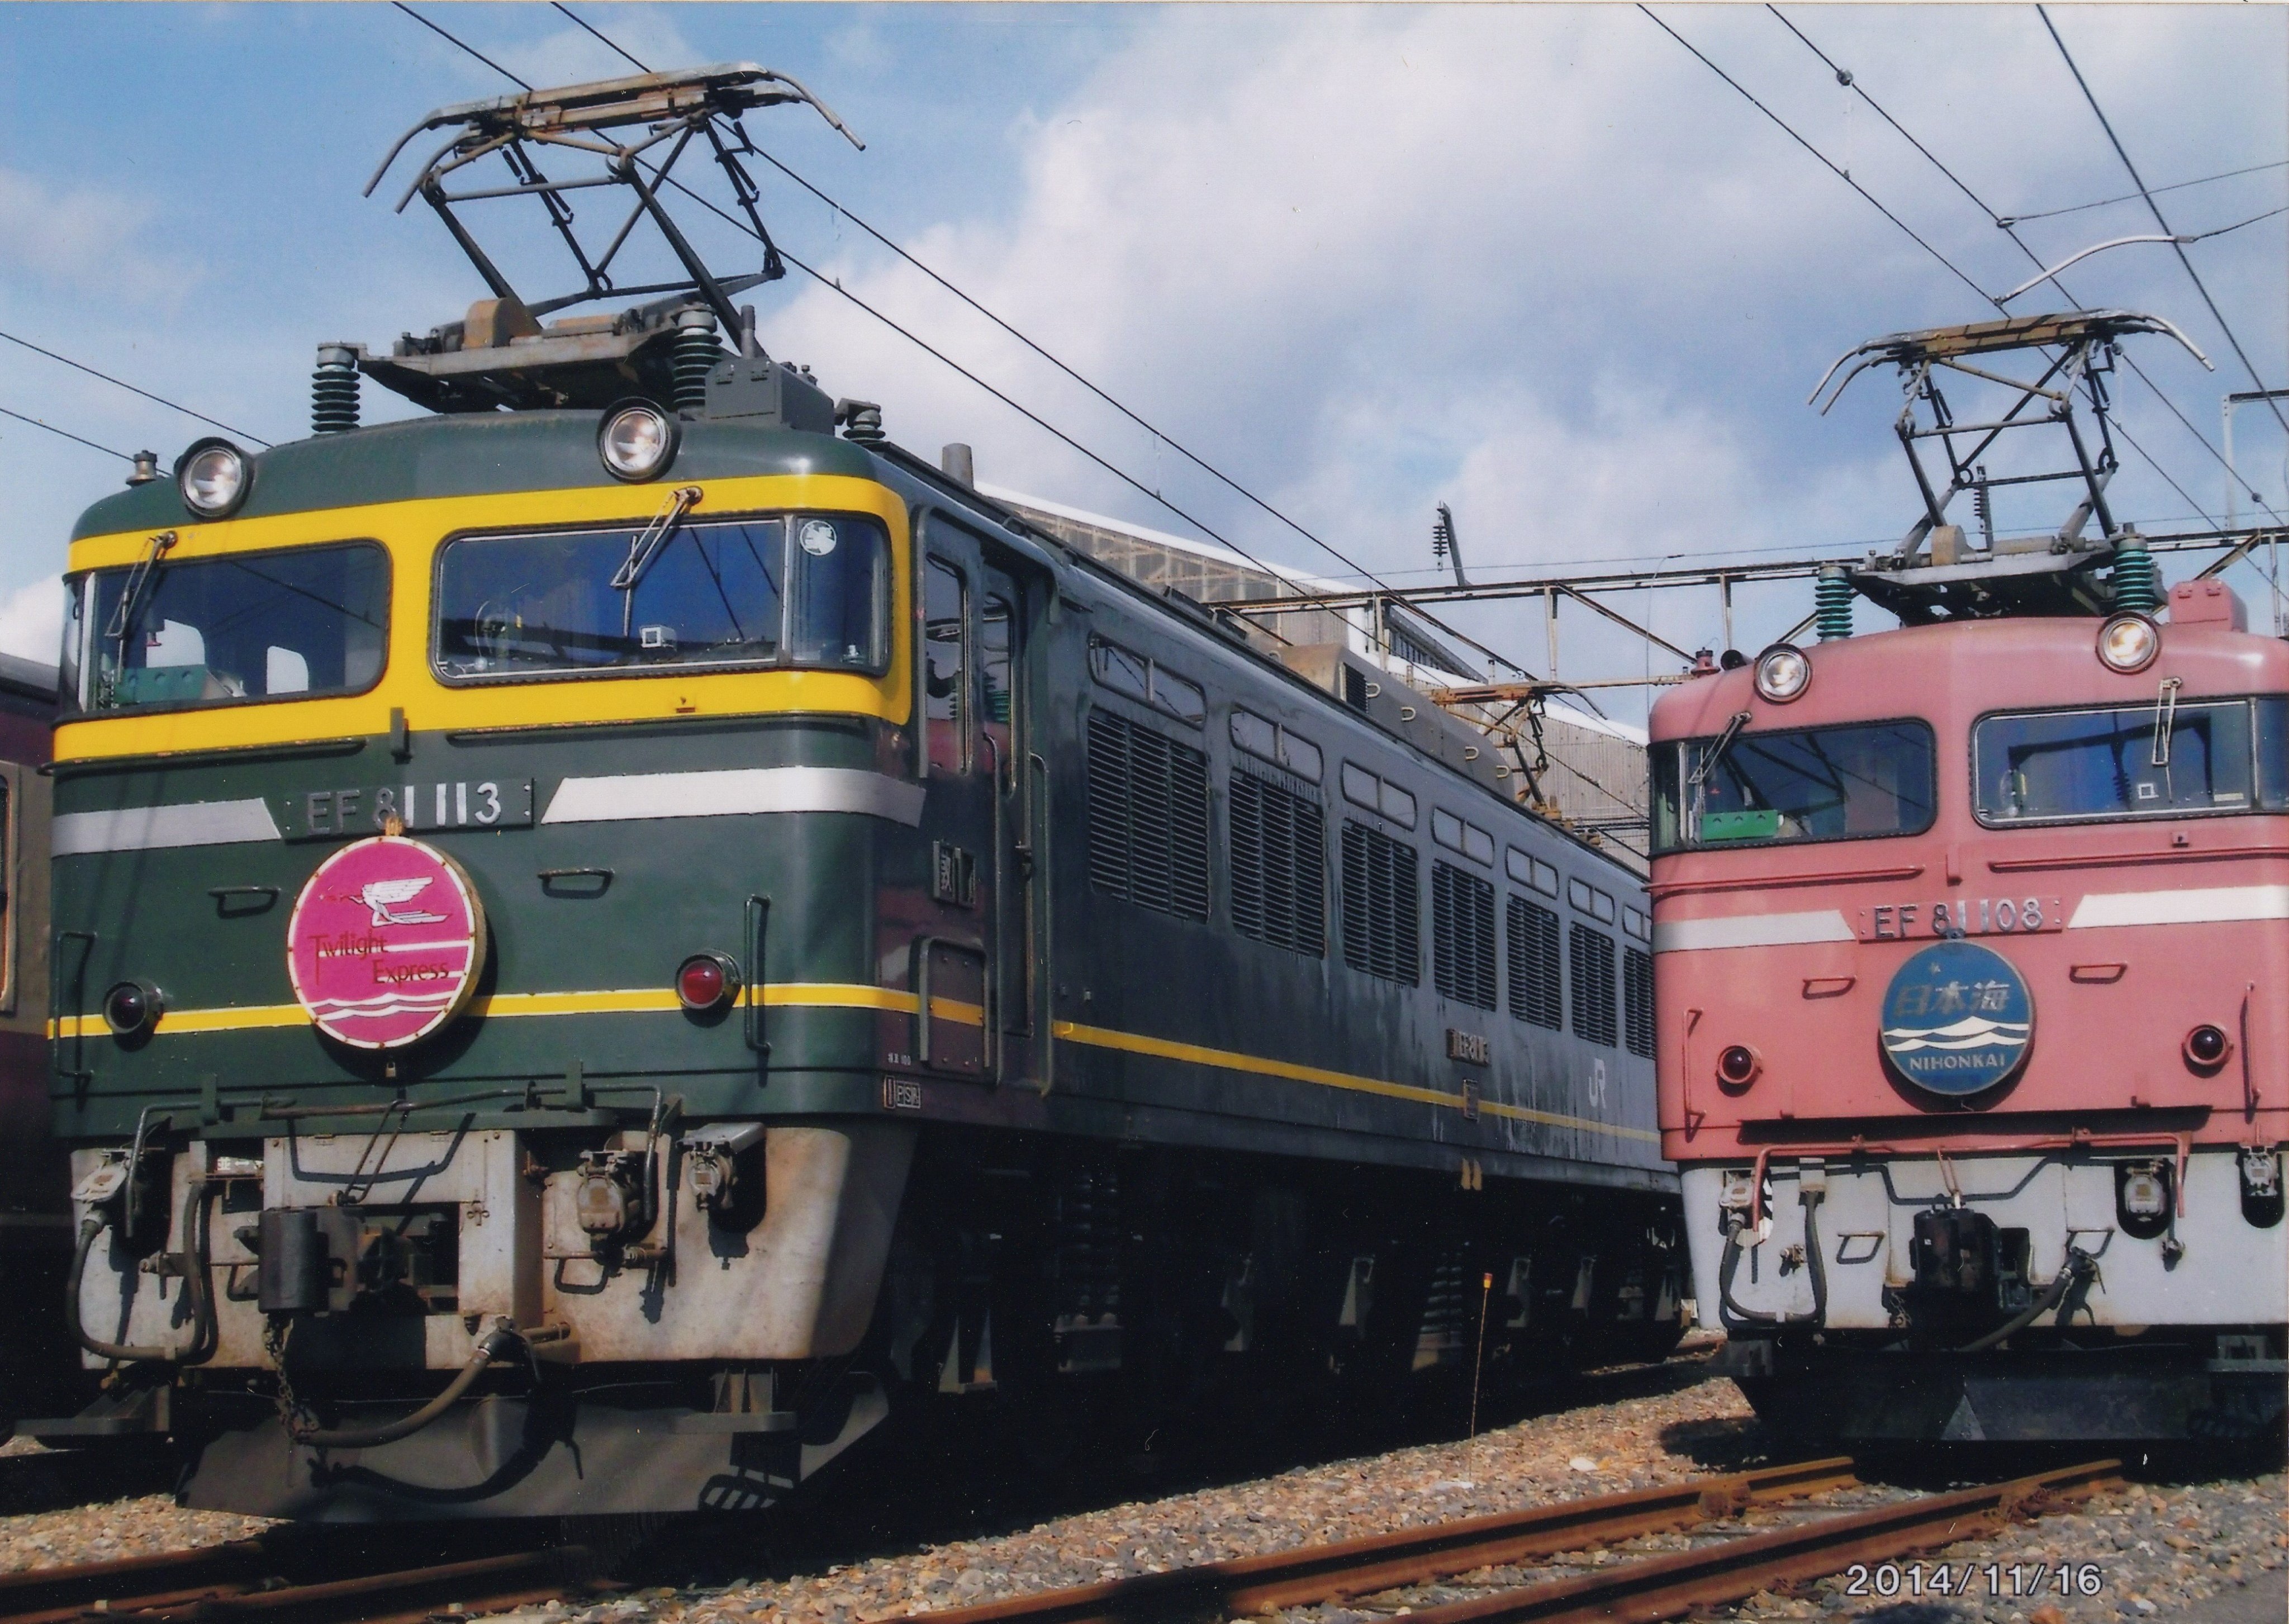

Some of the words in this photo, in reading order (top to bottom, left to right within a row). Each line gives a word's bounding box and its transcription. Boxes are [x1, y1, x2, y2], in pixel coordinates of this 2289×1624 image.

[308, 789, 359, 835] EF
[436, 782, 501, 827] 113
[1875, 904, 1918, 939] EF
[1980, 898, 2043, 933] 108
[308, 928, 388, 986] Twilight
[372, 958, 449, 989] Express
[1894, 980, 2011, 1017] 日本海
[1910, 1053, 2006, 1071] NIHONKAI
[1588, 1057, 1606, 1109] JR
